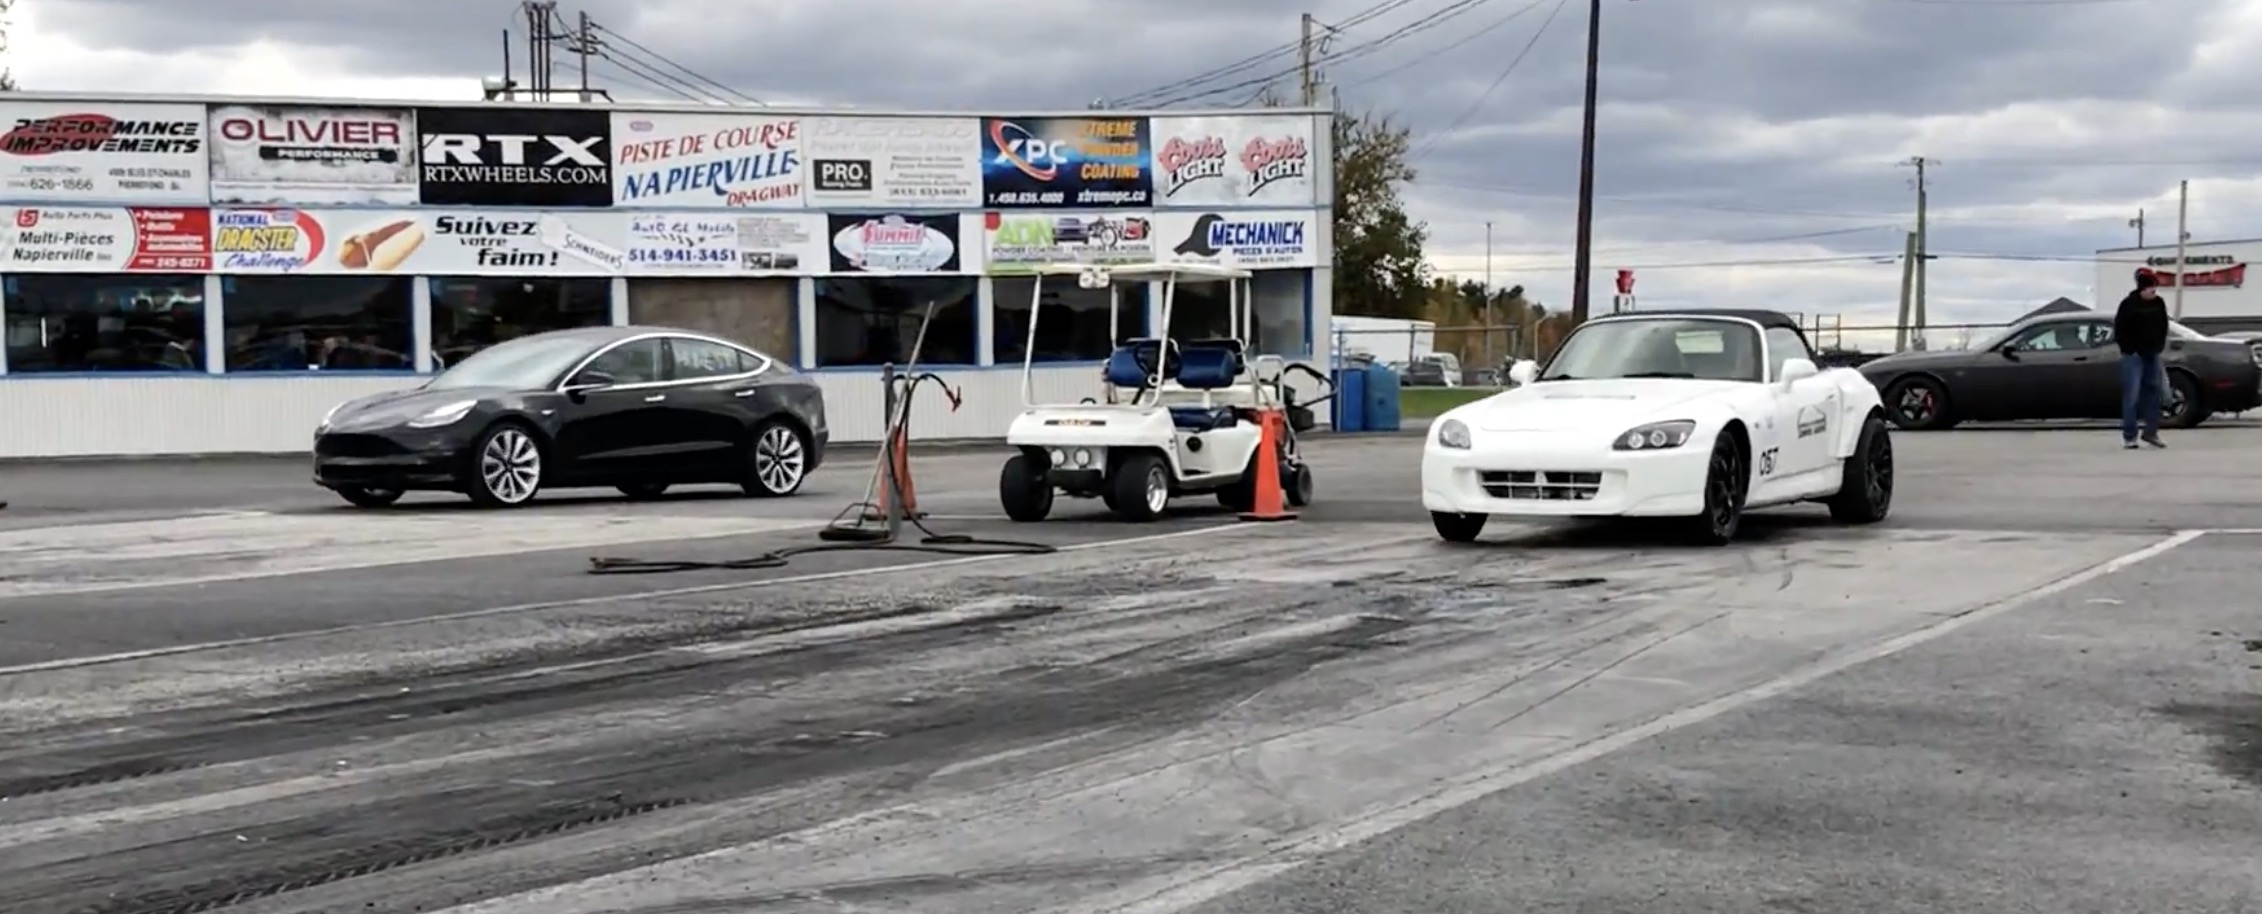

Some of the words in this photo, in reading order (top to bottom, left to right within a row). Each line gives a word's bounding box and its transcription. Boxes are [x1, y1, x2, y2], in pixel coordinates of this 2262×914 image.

[13, 119, 200, 136] PERFORMANCE
[221, 118, 400, 145] OLIVIER
[6, 136, 201, 154] IMPROVEMENTS
[277, 149, 380, 159] PERFORMANCE
[421, 133, 607, 166] RTX
[620, 138, 675, 165] PISTE
[678, 134, 707, 156] DE
[713, 120, 799, 150] COURSE
[993, 138, 1068, 164] XPC
[1157, 136, 1227, 173] Coors
[1239, 136, 1307, 173] Coors
[424, 166, 608, 184] RTXWHEELS.COM
[622, 149, 800, 201] NAPIERVILLE
[1081, 163, 1140, 179] COATING
[1165, 158, 1225, 198] LIGHT
[1248, 158, 1305, 198] LIGHT
[30, 178, 94, 191] 626-1866
[726, 183, 801, 207] DRAGWAY
[218, 214, 269, 225] NATIONAL
[435, 215, 537, 236] Suivez
[18, 231, 115, 246] Multi-Pièces
[216, 225, 299, 253] DRAGSTER
[460, 237, 508, 246] votre
[1211, 220, 1305, 246] MECHANICK
[13, 248, 94, 262] Napierville
[224, 253, 305, 271] Challenge
[563, 233, 623, 270] SCHNEIDERS
[628, 249, 737, 263] 514-941-3451
[1759, 446, 1779, 477] 057
